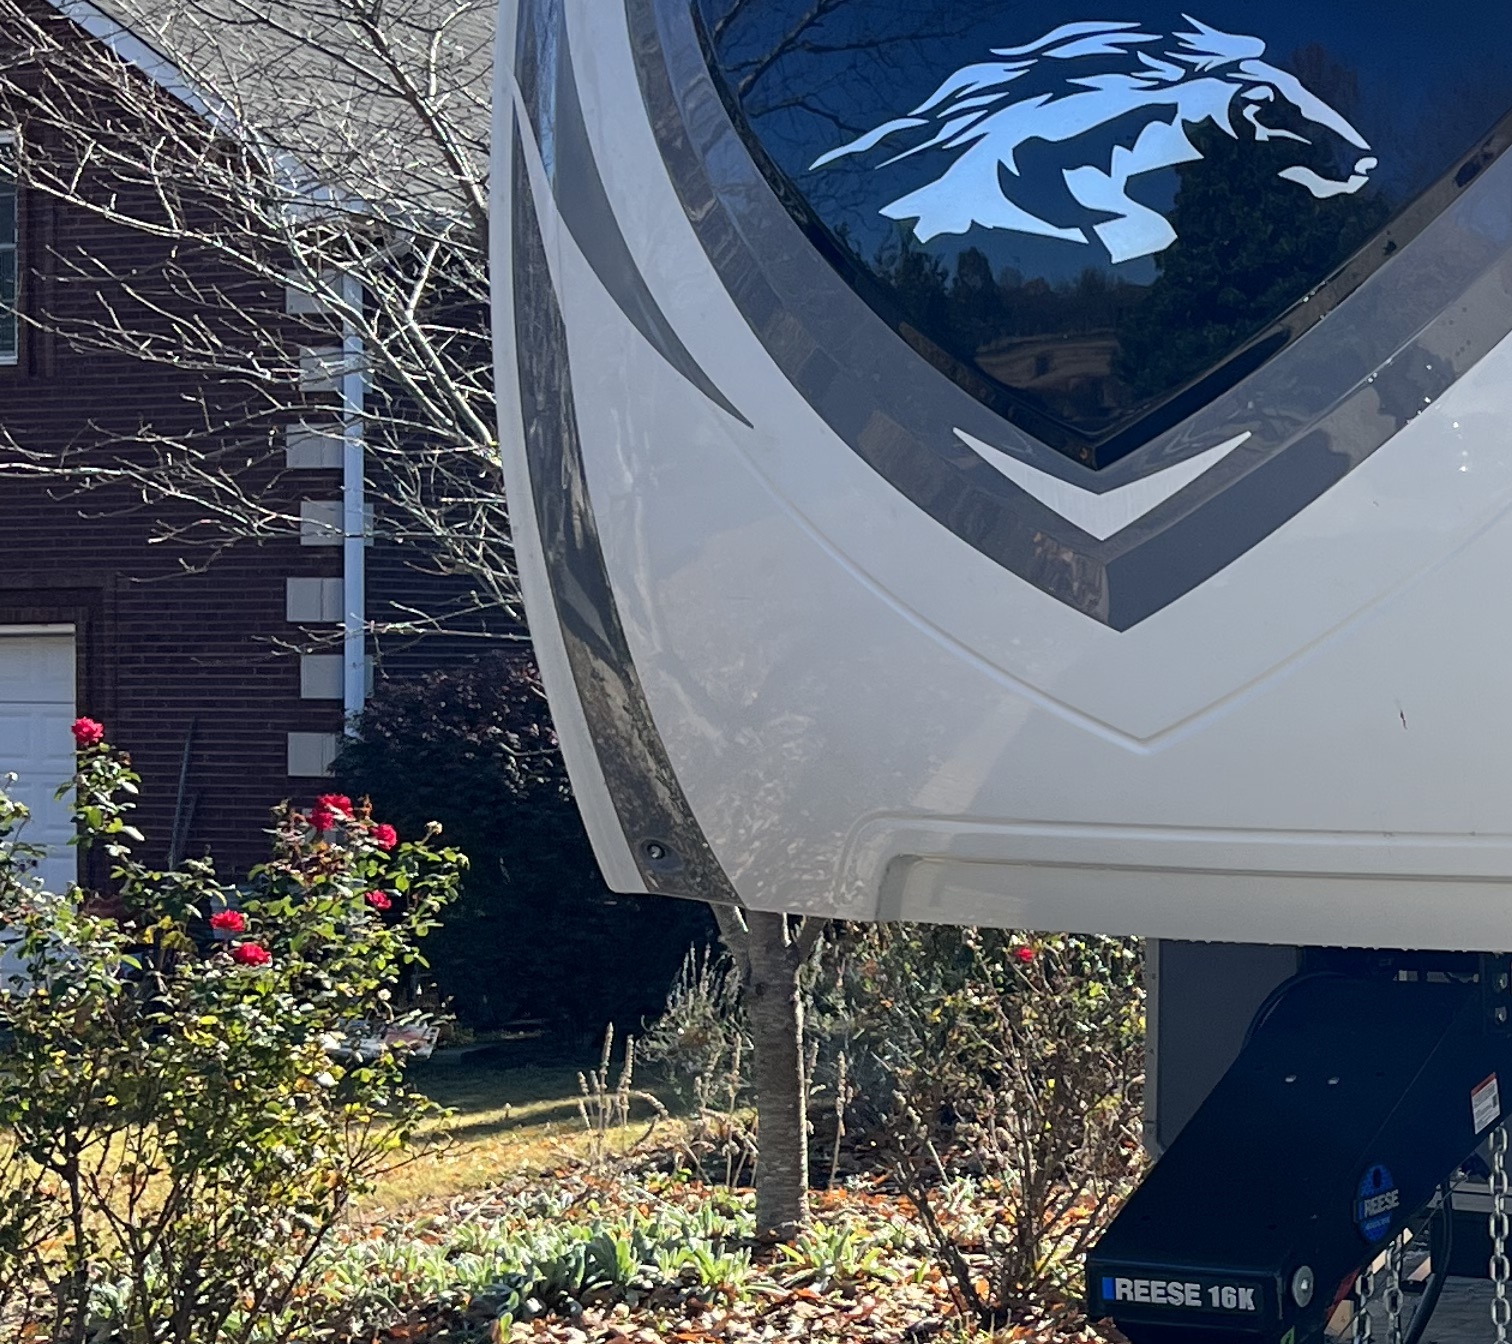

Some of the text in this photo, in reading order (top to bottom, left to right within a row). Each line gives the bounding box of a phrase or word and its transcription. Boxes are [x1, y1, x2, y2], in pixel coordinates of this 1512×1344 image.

[1363, 1189, 1400, 1218] REESE
[1115, 1277, 1256, 1311] REESE 16K
